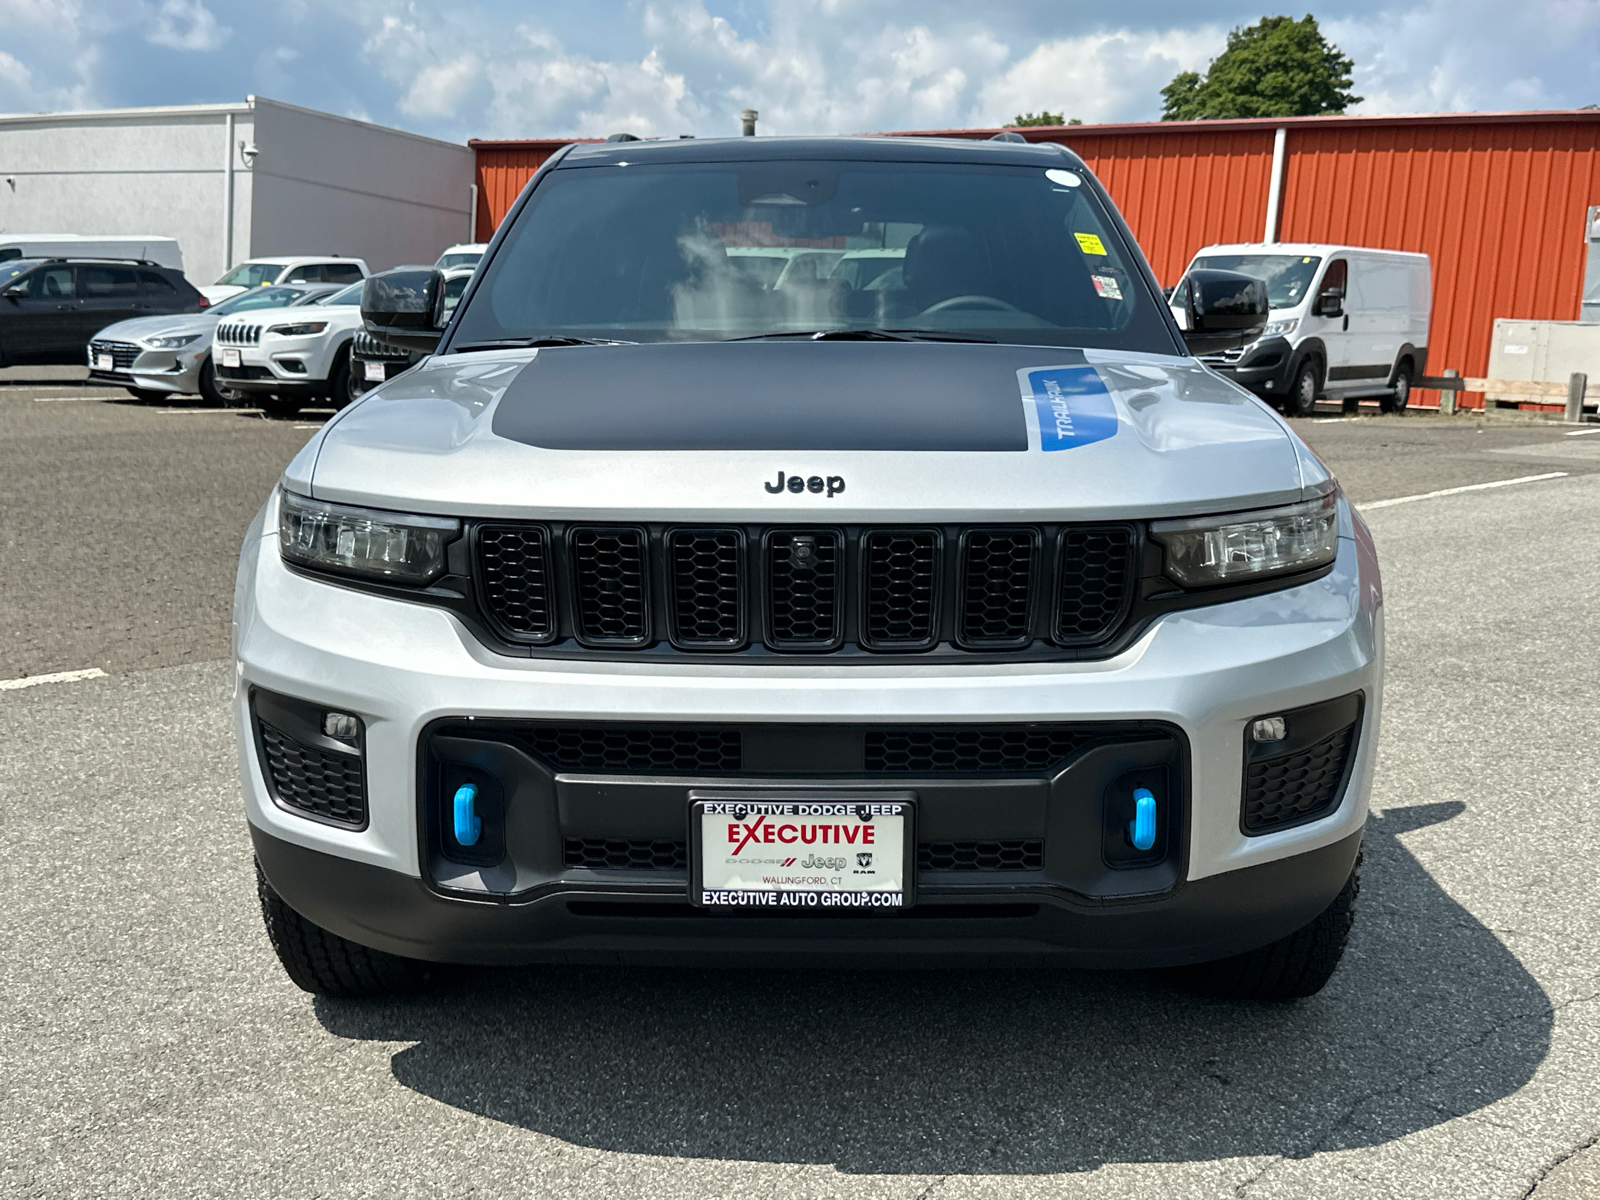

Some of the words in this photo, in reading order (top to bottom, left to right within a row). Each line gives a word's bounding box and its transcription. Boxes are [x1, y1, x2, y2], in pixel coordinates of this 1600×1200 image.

[1042, 379, 1075, 440] TRAILHAWK
[764, 471, 846, 498] Jeep
[703, 803, 794, 816] EXECUTIVE
[799, 804, 857, 816] DODGE
[861, 804, 902, 816] JEEP
[727, 815, 875, 856] EXECUTIVE
[801, 853, 847, 872] Jeep
[762, 876, 829, 886] WALLINGFORD,
[830, 876, 843, 885] CT
[702, 891, 778, 906] EXECUTIVE
[780, 892, 818, 906] AUTO
[821, 892, 903, 907] GROUP.COM
